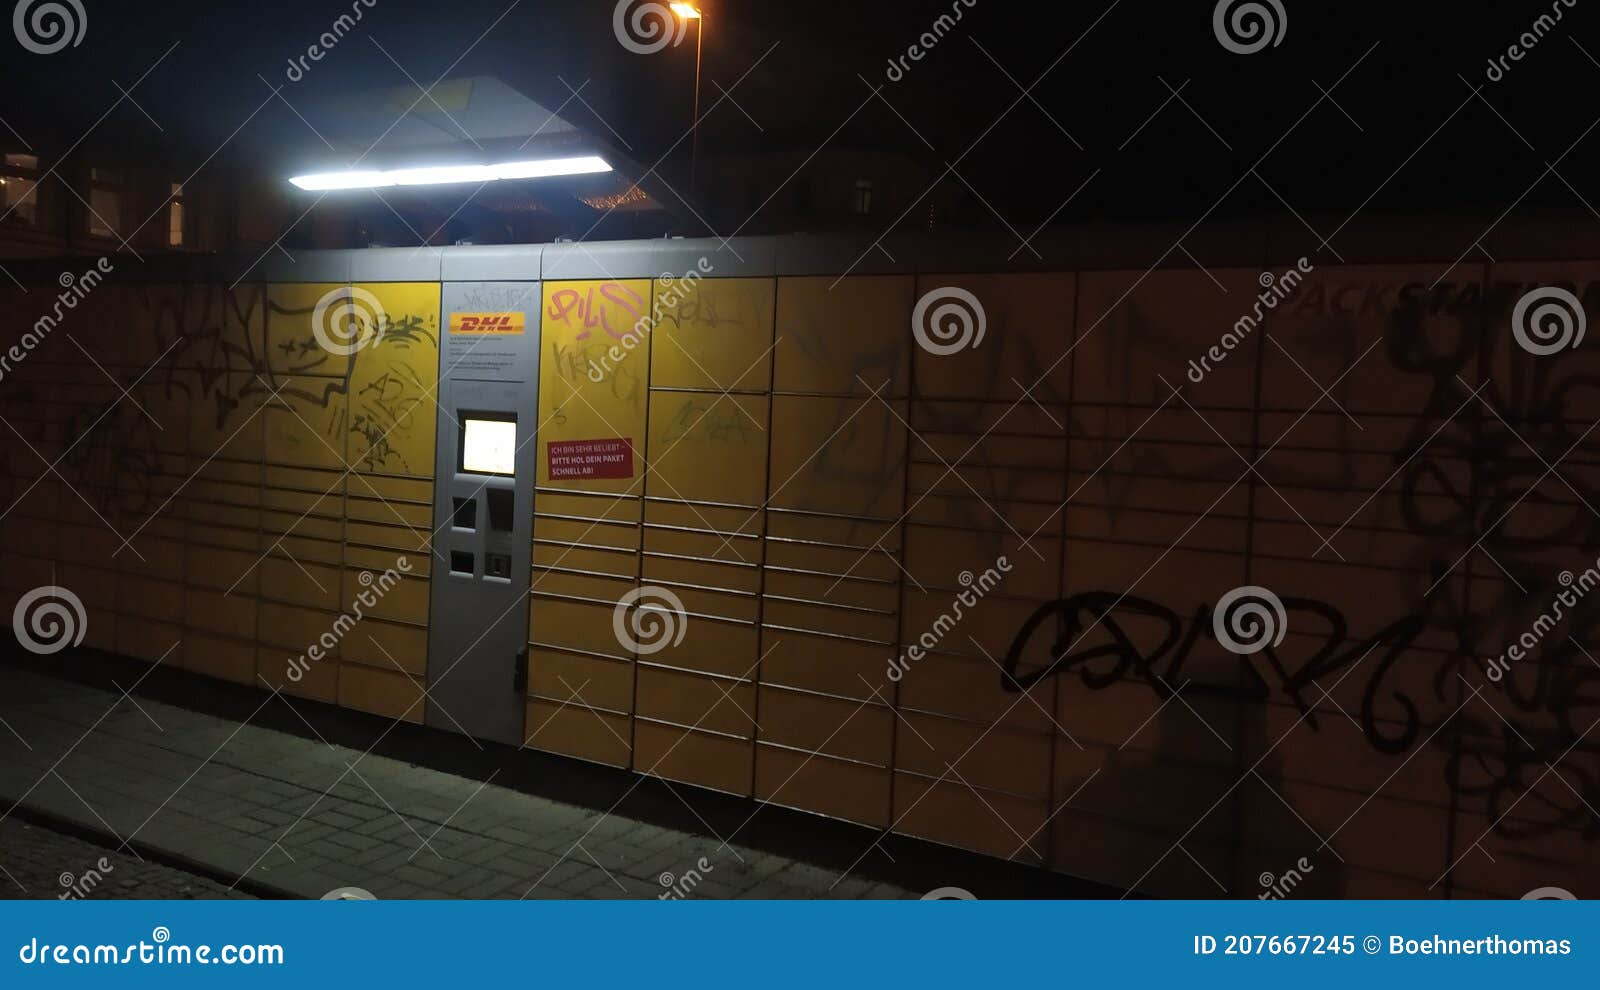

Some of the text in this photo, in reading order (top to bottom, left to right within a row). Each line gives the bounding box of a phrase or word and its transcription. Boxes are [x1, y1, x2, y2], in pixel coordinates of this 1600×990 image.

[460, 317, 513, 331] DHL
[551, 446, 562, 455] ICH
[563, 446, 575, 454] BIN
[575, 445, 593, 454] SEHR
[593, 443, 620, 452] BELIEBT
[551, 454, 625, 465] BITTE HOL DEIN PAKET
[552, 467, 581, 476] SCHNELL
